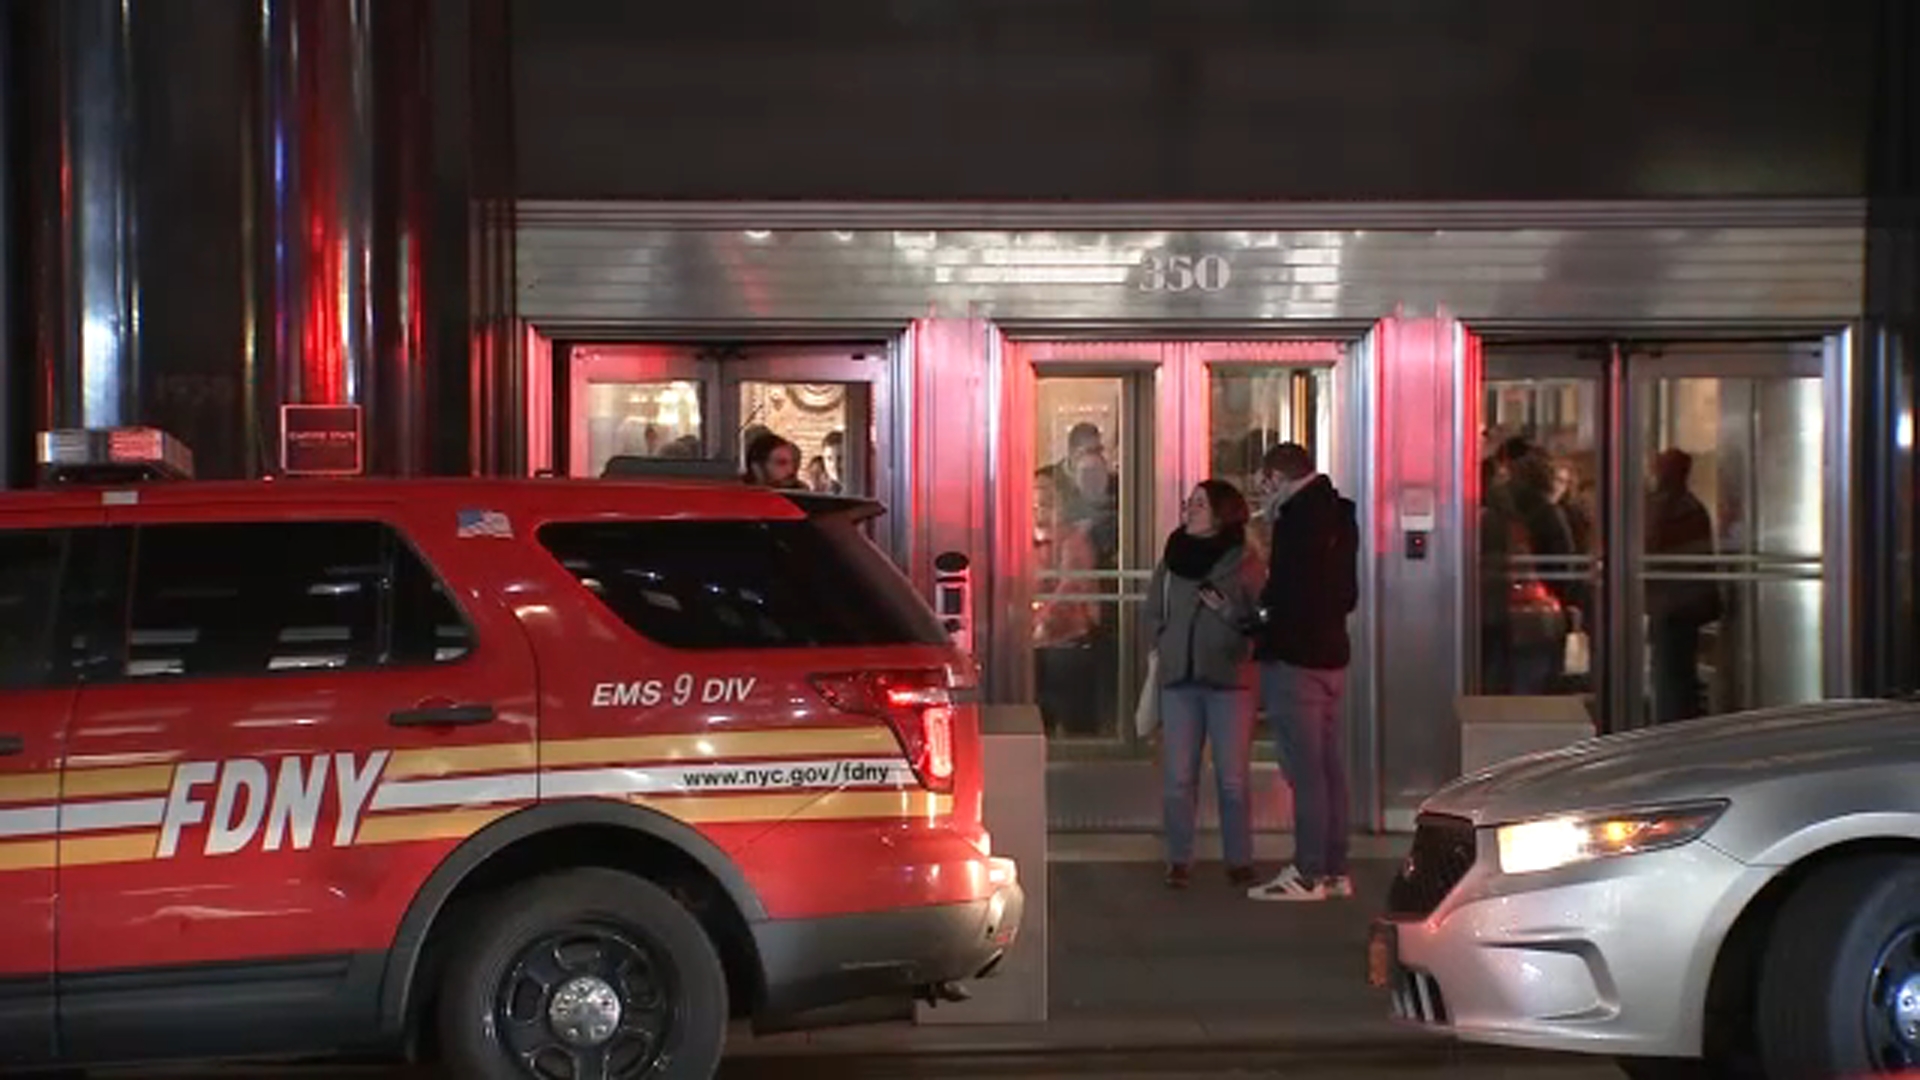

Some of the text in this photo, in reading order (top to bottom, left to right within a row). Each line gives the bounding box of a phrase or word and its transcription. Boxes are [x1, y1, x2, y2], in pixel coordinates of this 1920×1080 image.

[1139, 254, 1231, 292] 350
[592, 673, 756, 707] EMS 9 DIV
[683, 761, 889, 787] www.nyc.gov/fdny
[155, 749, 391, 858] FDNY
